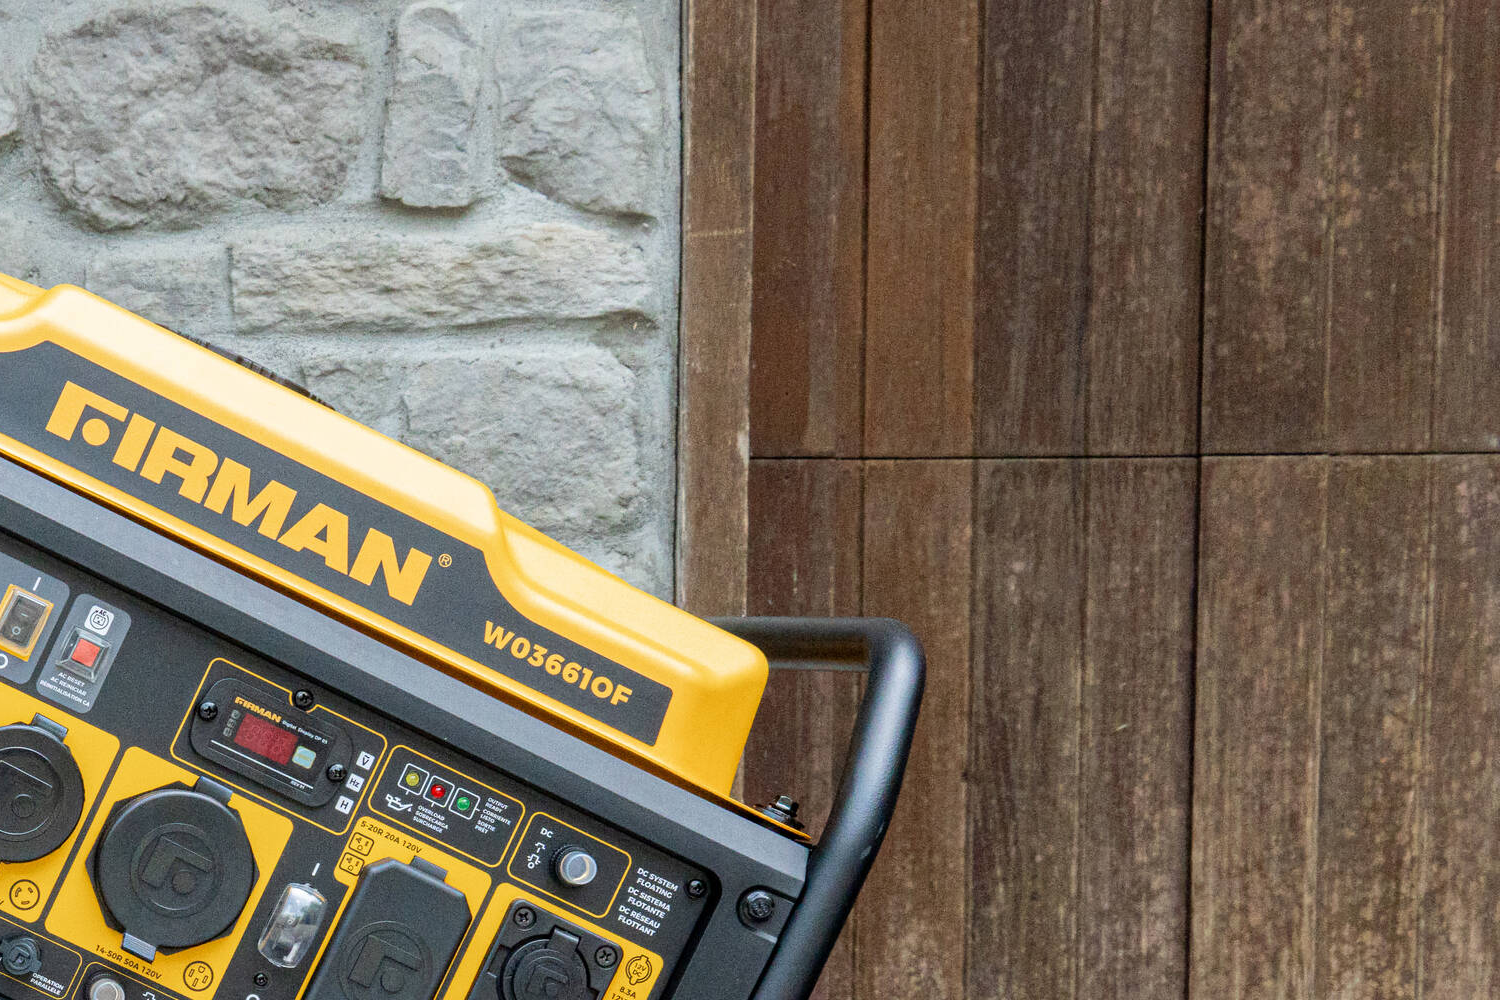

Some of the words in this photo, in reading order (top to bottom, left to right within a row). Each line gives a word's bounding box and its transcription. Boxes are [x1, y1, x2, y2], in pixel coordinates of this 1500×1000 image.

[45, 380, 432, 605] FIRMAN
[50, 676, 61, 684] AC
[58, 671, 68, 679] AC
[69, 676, 85, 687] RESET
[234, 696, 282, 723] FIRMAN
[349, 778, 360, 787] Hz
[340, 801, 348, 809] H
[417, 805, 445, 820] OVERLOAD
[415, 811, 449, 829] SOBRECARGA
[361, 821, 383, 835] 5-20R
[384, 832, 401, 843] 20A
[402, 840, 422, 853] 120V
[540, 828, 553, 838] DC
[637, 868, 648, 877] DC
[648, 873, 678, 891] SYSTEM
[637, 878, 673, 898] FLOATING
[627, 897, 665, 918] FLOTANTE
[628, 887, 639, 896] DC
[639, 892, 671, 911] SISTEMA
[618, 905, 630, 914] DC
[630, 909, 661, 928] RÉSEAU
[618, 915, 655, 936] FLOTTANT
[95, 945, 122, 961] 14-50R
[124, 958, 139, 969] 50A
[141, 967, 162, 980] 120V
[634, 963, 646, 972] 12V
[632, 969, 642, 977] DC
[619, 986, 637, 998] 8.3A
